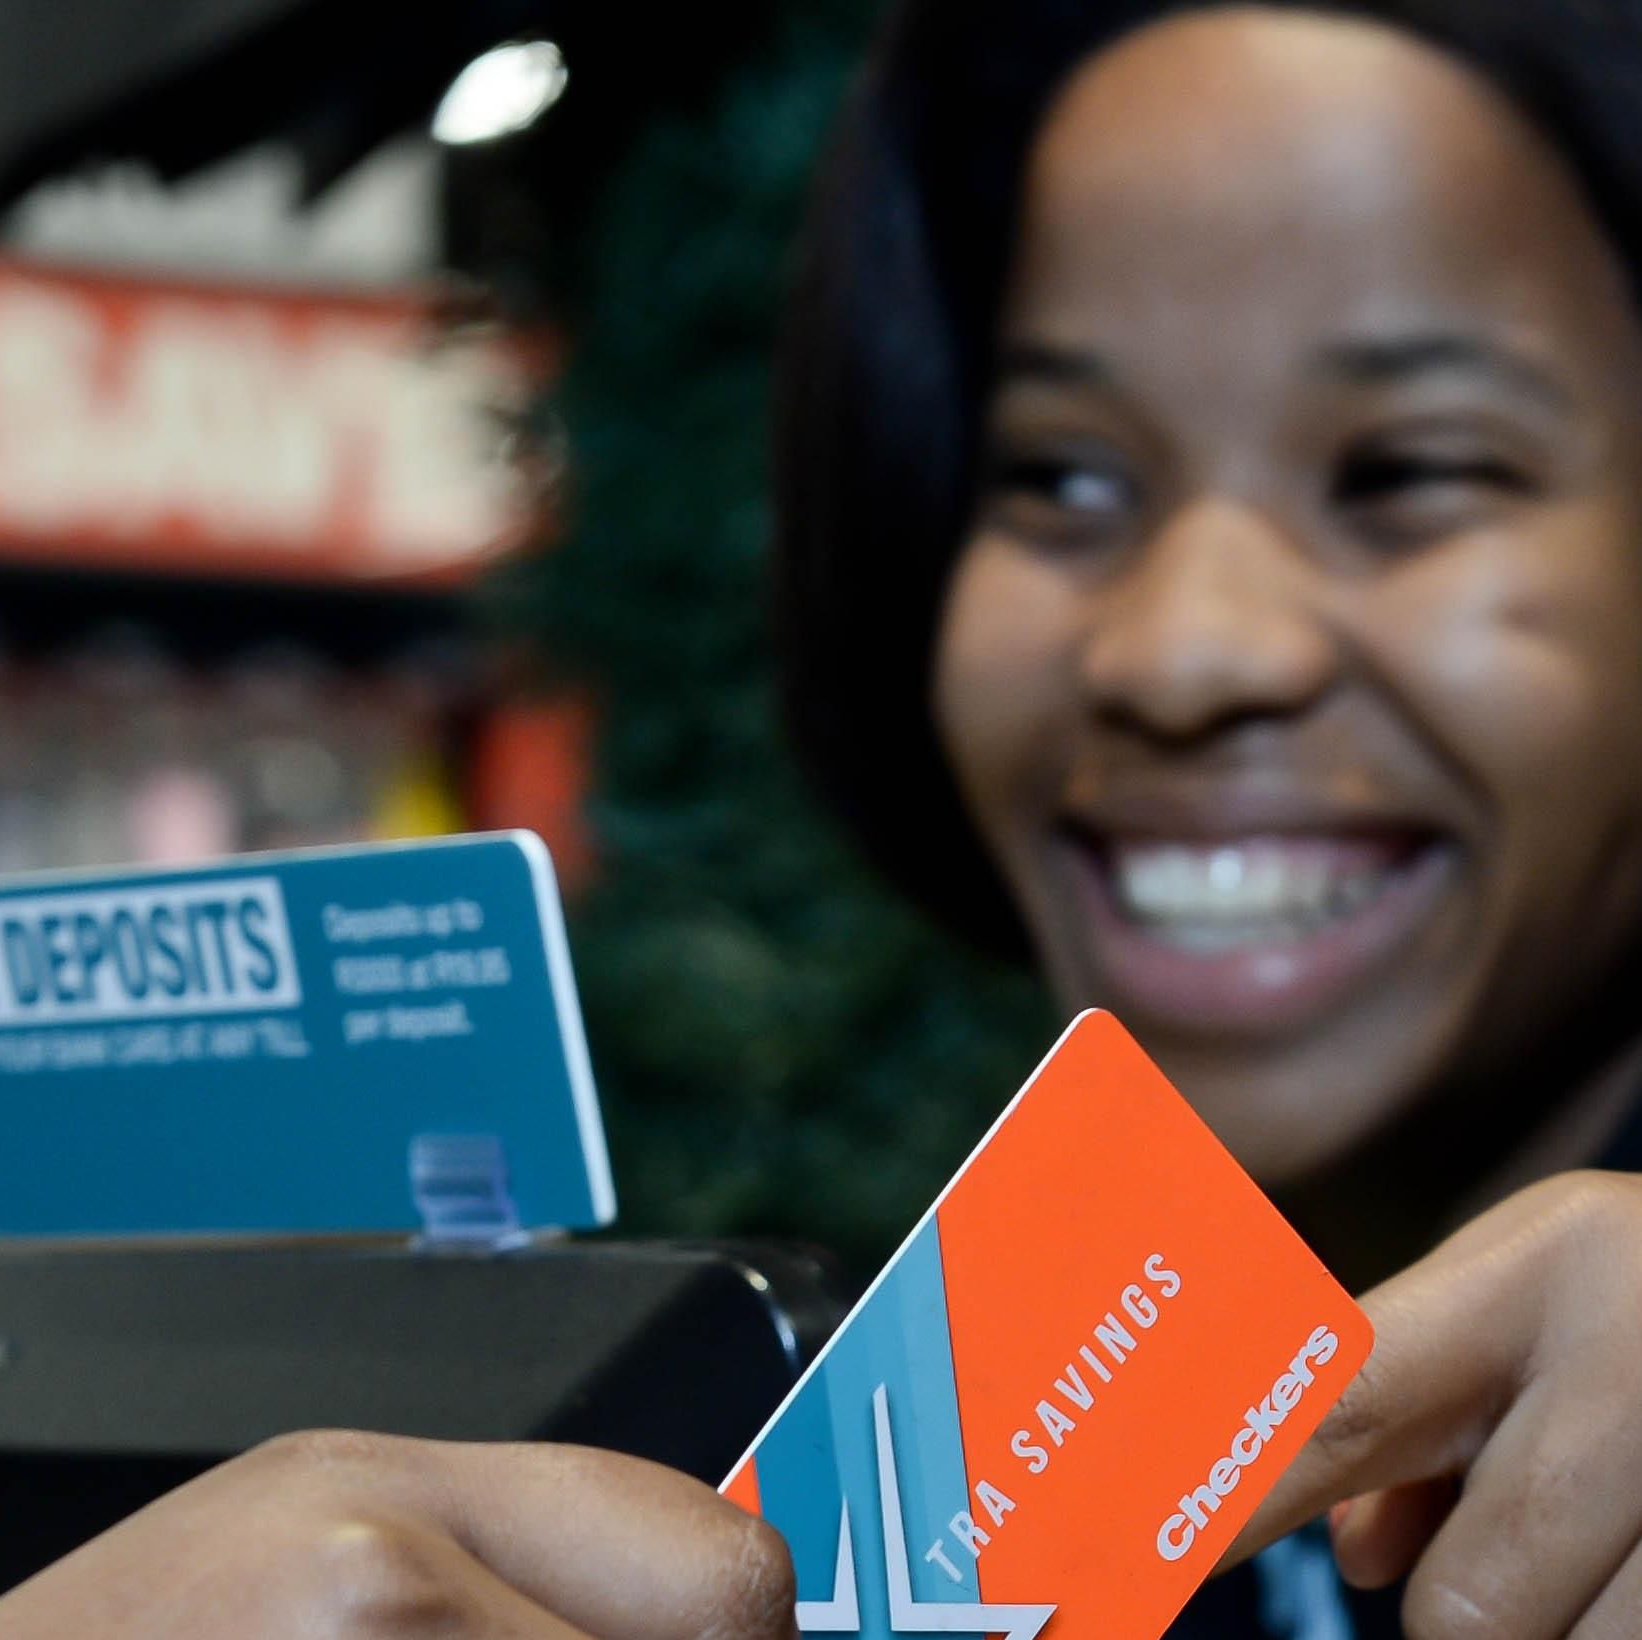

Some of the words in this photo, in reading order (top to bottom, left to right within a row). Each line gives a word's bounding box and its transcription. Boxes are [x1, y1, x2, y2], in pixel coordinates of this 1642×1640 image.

[2, 896, 280, 1006] DEPOSITS
[925, 1480, 1017, 1583] TRA
[1010, 1254, 1183, 1475] SAVINGS
[1157, 1325, 1339, 1562] Checkers
